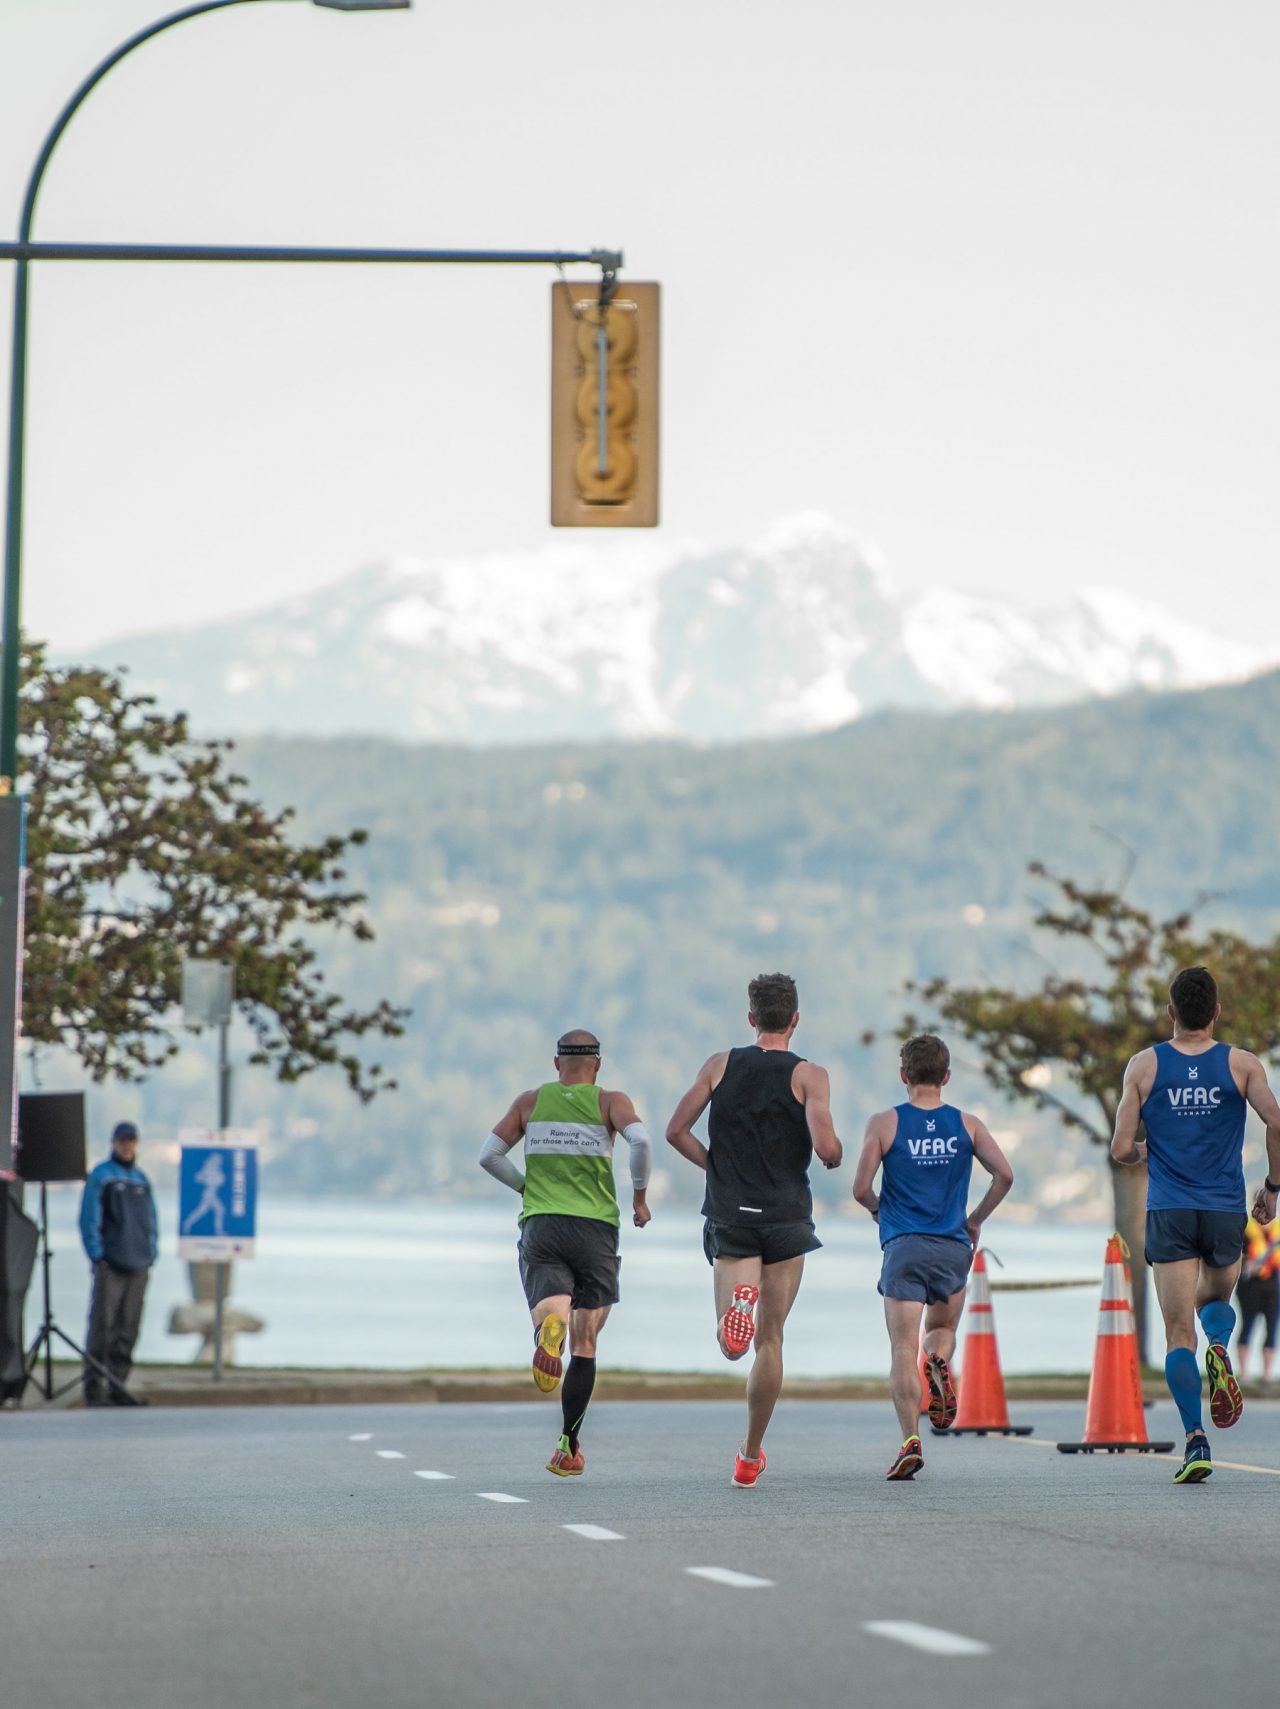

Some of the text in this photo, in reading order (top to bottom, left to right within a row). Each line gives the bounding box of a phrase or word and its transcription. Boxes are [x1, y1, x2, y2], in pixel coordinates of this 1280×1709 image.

[1167, 1086, 1221, 1106] VFAC
[550, 1129, 580, 1139] Running
[530, 1138, 541, 1146] for
[907, 1136, 958, 1156] VFAC
